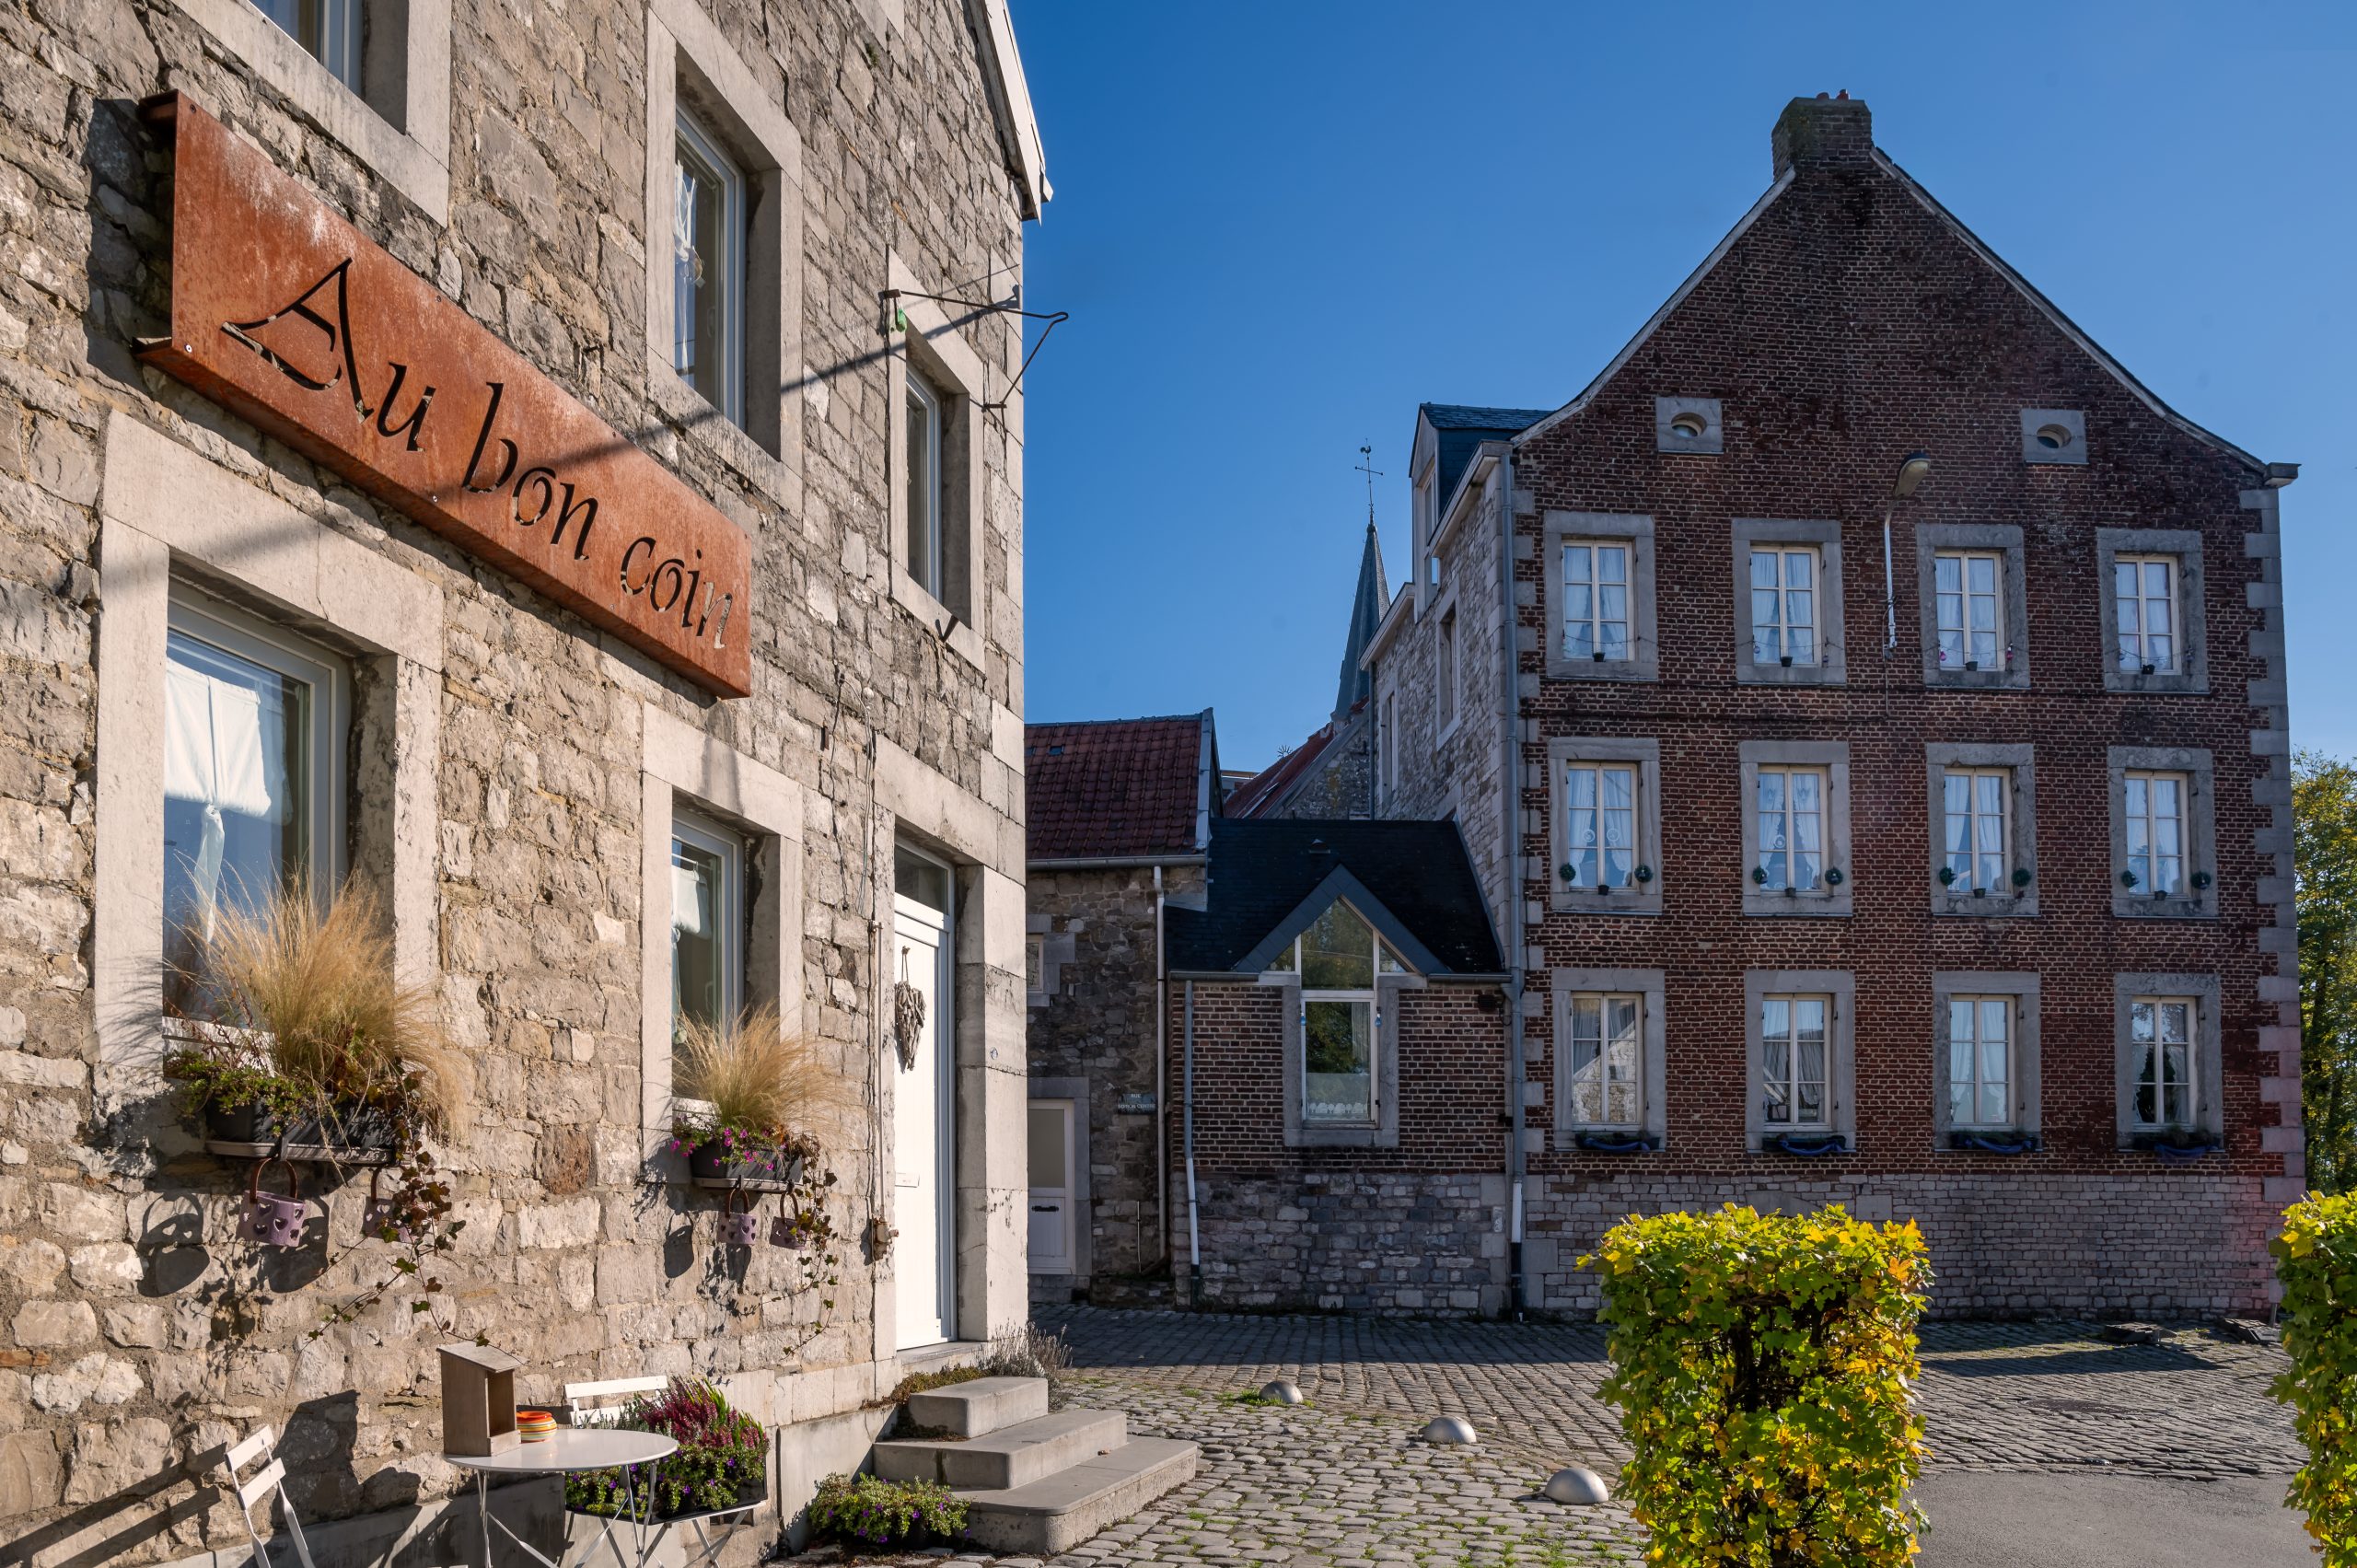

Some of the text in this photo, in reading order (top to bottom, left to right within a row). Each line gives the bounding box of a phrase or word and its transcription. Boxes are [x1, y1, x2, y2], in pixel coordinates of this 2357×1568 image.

[219, 256, 734, 649] Au bon coin
